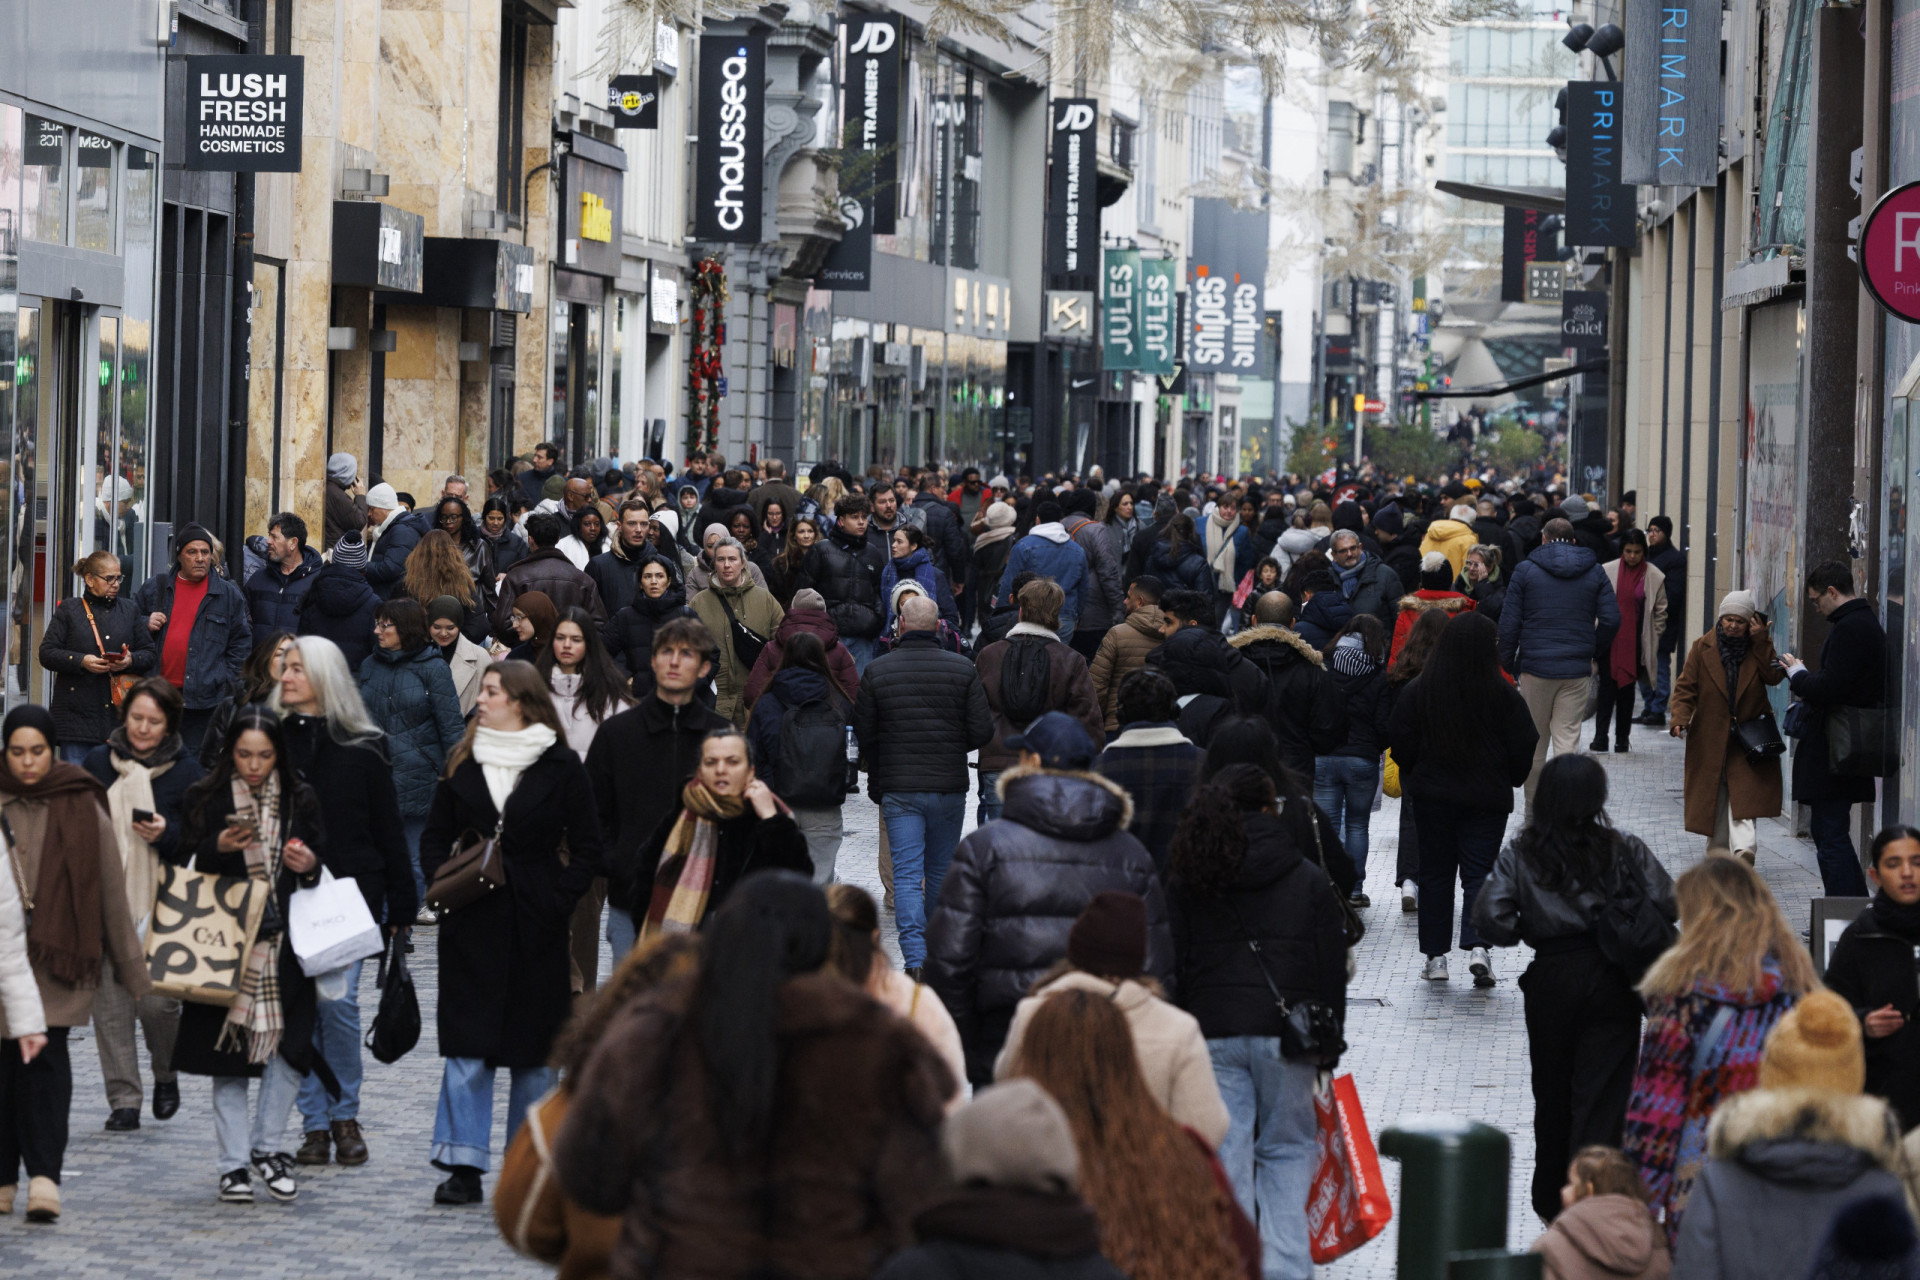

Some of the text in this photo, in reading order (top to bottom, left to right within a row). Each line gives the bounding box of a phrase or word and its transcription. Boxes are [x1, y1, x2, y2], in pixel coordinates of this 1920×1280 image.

[850, 21, 896, 54] JD
[200, 73, 287, 98] LUSH
[863, 58, 879, 143] TRAINERS
[200, 101, 286, 122] FRESH
[1056, 104, 1094, 130] JD
[199, 139, 285, 153] COSMETICS
[200, 124, 285, 137] HANDMADE
[1067, 133, 1081, 201] TRAINERS
[1591, 90, 1614, 234] PRIMARK
[1066, 215, 1078, 250] KING
[1109, 264, 1133, 356] JULES
[1145, 273, 1170, 362] JULES
[1194, 276, 1232, 365] snipes
[193, 926, 228, 948] C&A
